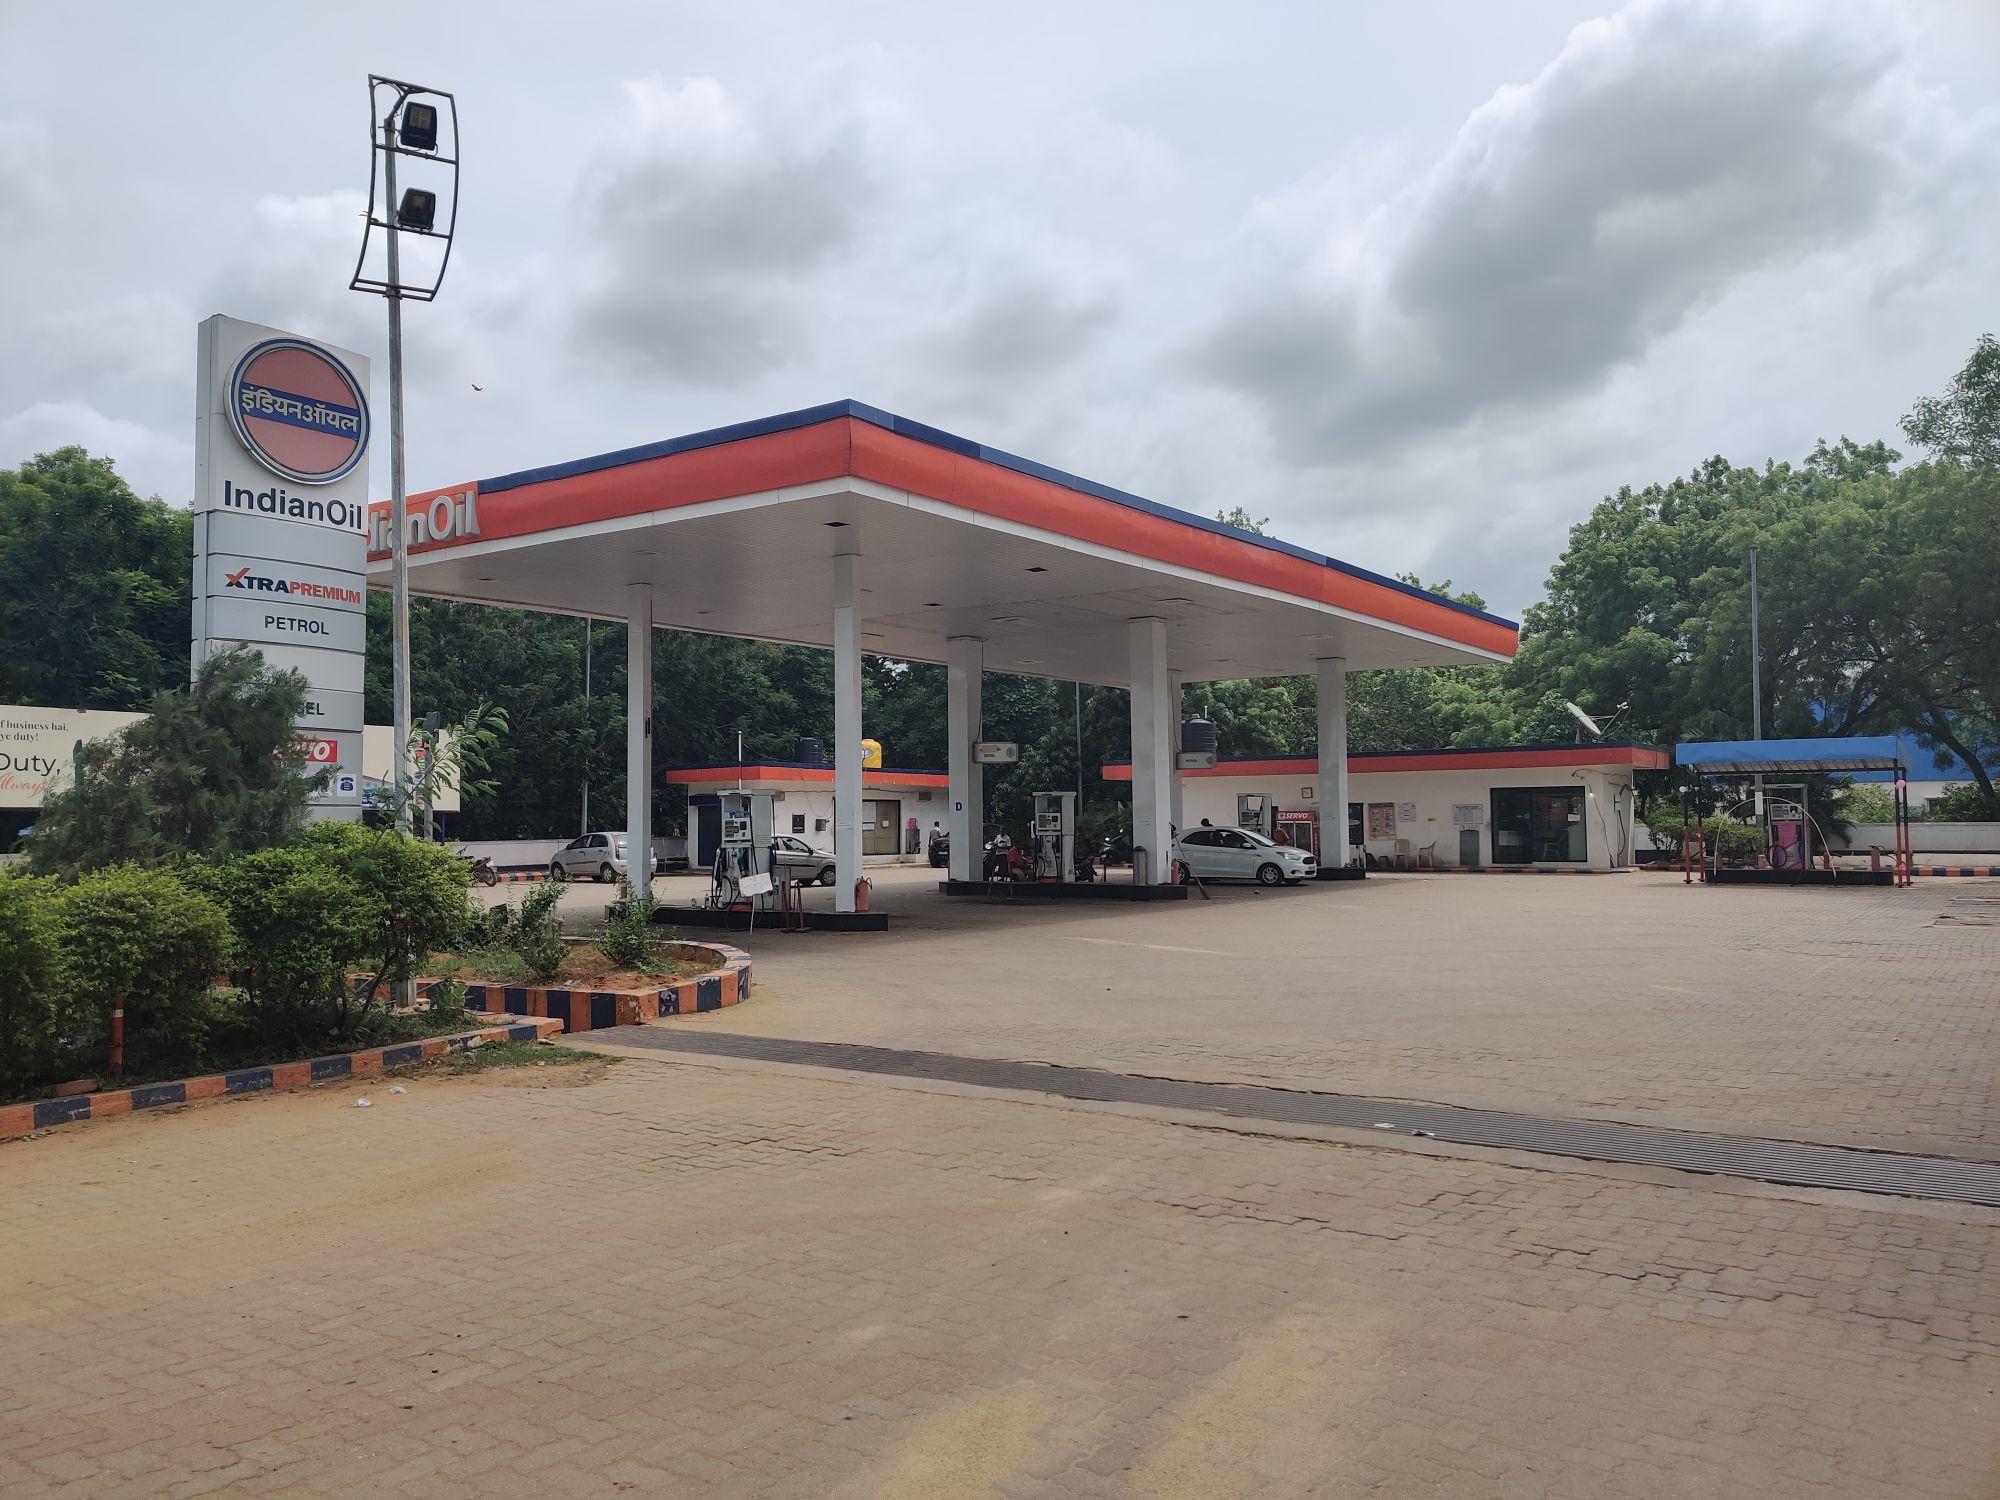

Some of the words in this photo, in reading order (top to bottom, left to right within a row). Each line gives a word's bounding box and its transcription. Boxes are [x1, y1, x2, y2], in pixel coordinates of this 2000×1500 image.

[241, 386, 359, 432] इंडियनऑयल
[224, 480, 362, 530] IndianOil
[264, 615, 330, 635] PETROL
[6, 721, 49, 731] business
[13, 732, 39, 742] duty!
[955, 802, 962, 812] D
[1285, 812, 1309, 820] SERVO
